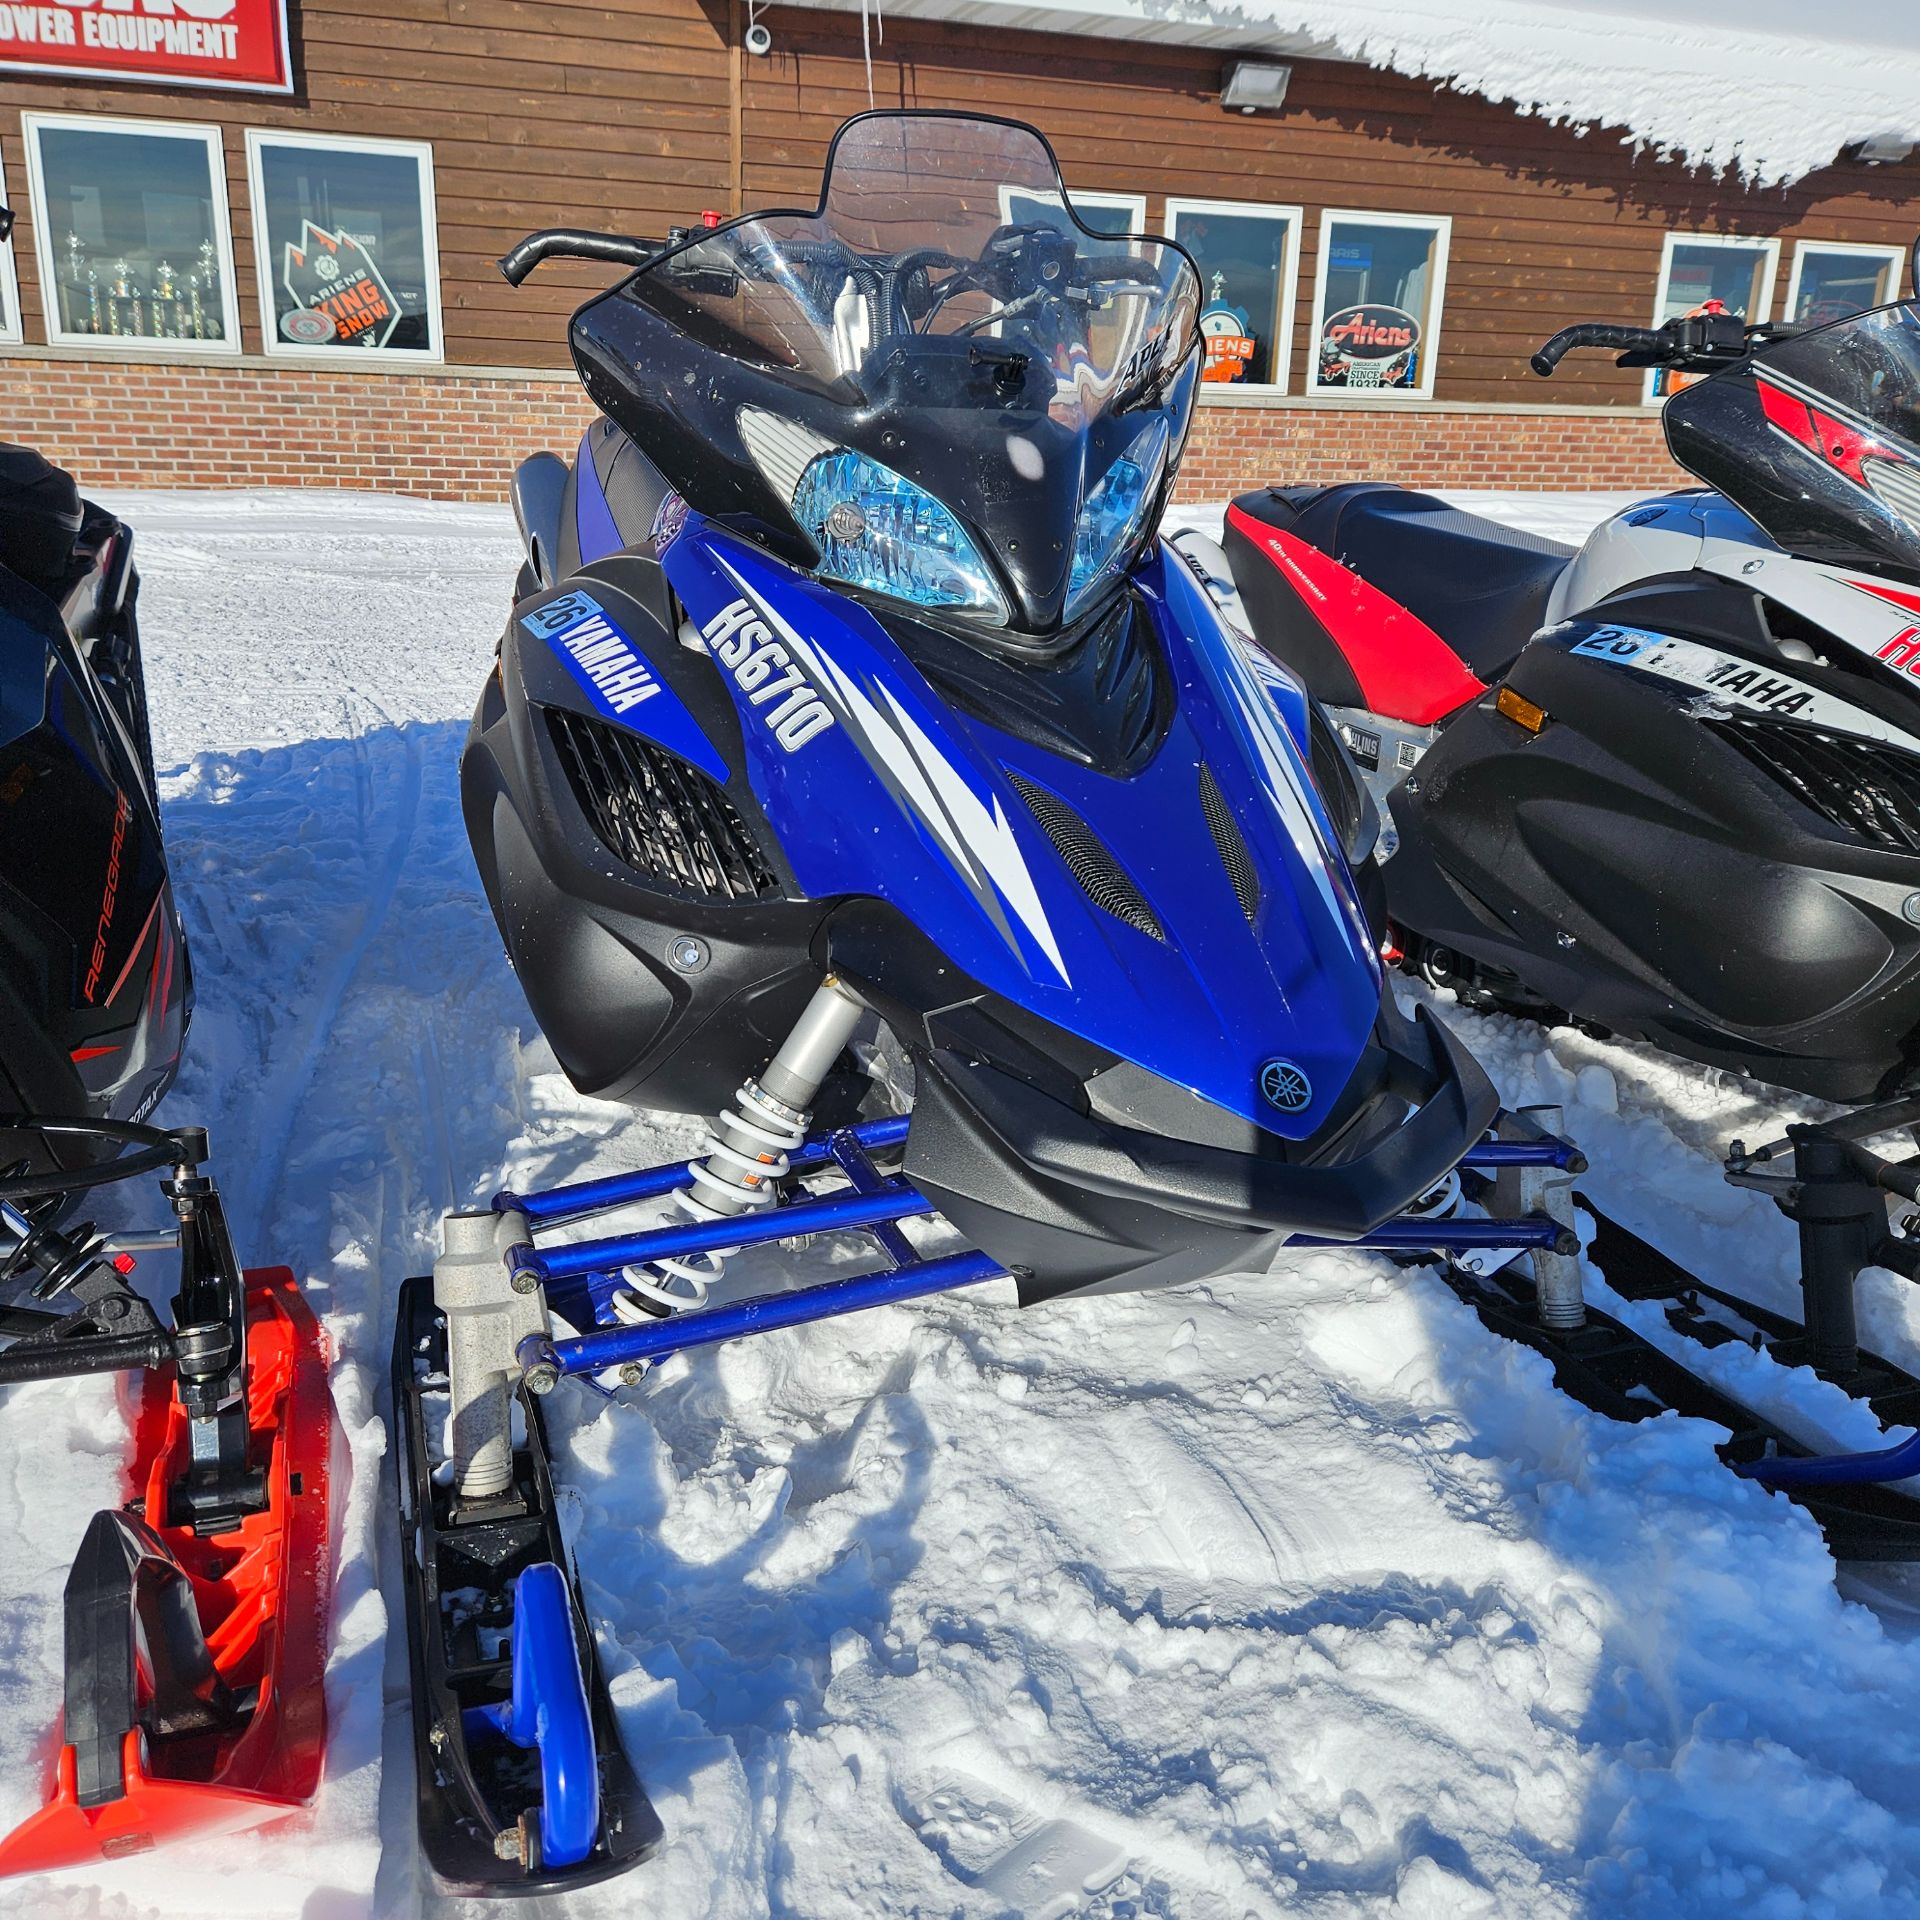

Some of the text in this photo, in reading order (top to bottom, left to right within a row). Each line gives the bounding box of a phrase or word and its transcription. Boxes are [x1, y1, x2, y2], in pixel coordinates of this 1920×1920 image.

[81, 10, 238, 60] EQUIPMENT
[309, 268, 367, 305] ARIENS
[312, 278, 380, 322] KING
[336, 299, 389, 340] SNOW
[1330, 312, 1411, 346] Ariens
[1350, 370, 1379, 379] SINCE
[533, 597, 587, 629] 26
[559, 615, 661, 714] YAMAHA
[701, 598, 835, 753] HS6710
[1347, 731, 1378, 755] HLINS
[84, 788, 127, 1003] RENEGADE
